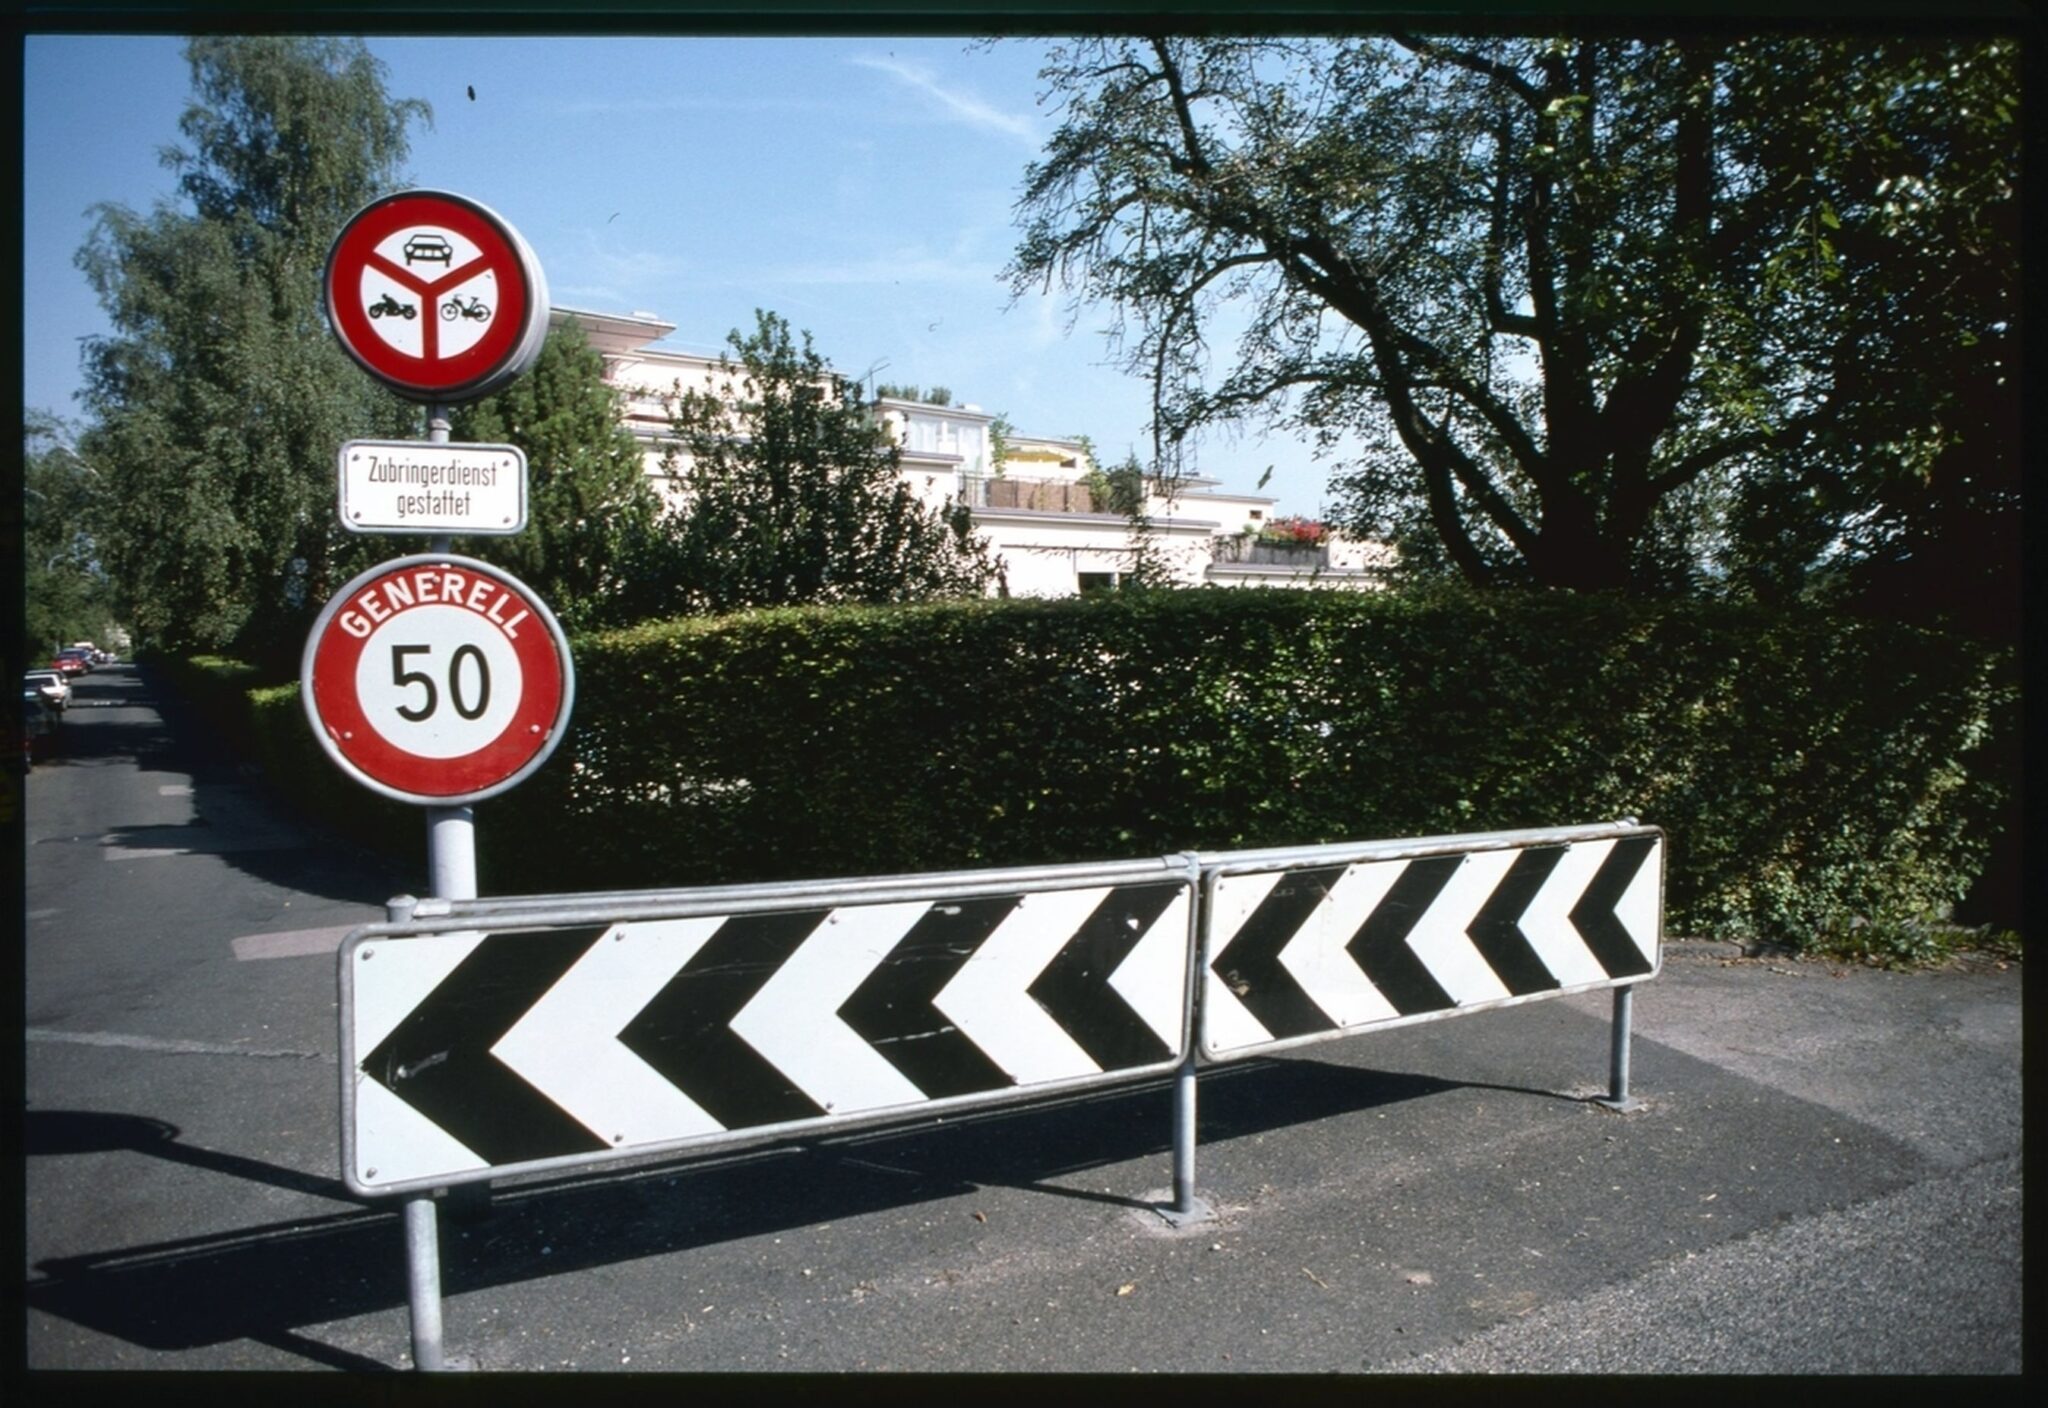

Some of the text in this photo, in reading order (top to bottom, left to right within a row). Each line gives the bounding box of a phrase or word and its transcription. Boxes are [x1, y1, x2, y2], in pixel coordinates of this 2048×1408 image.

[368, 455, 497, 488] Zubringerdienst
[397, 490, 471, 518] gestattet
[339, 571, 529, 639] GENERELL
[391, 643, 491, 722] 50
